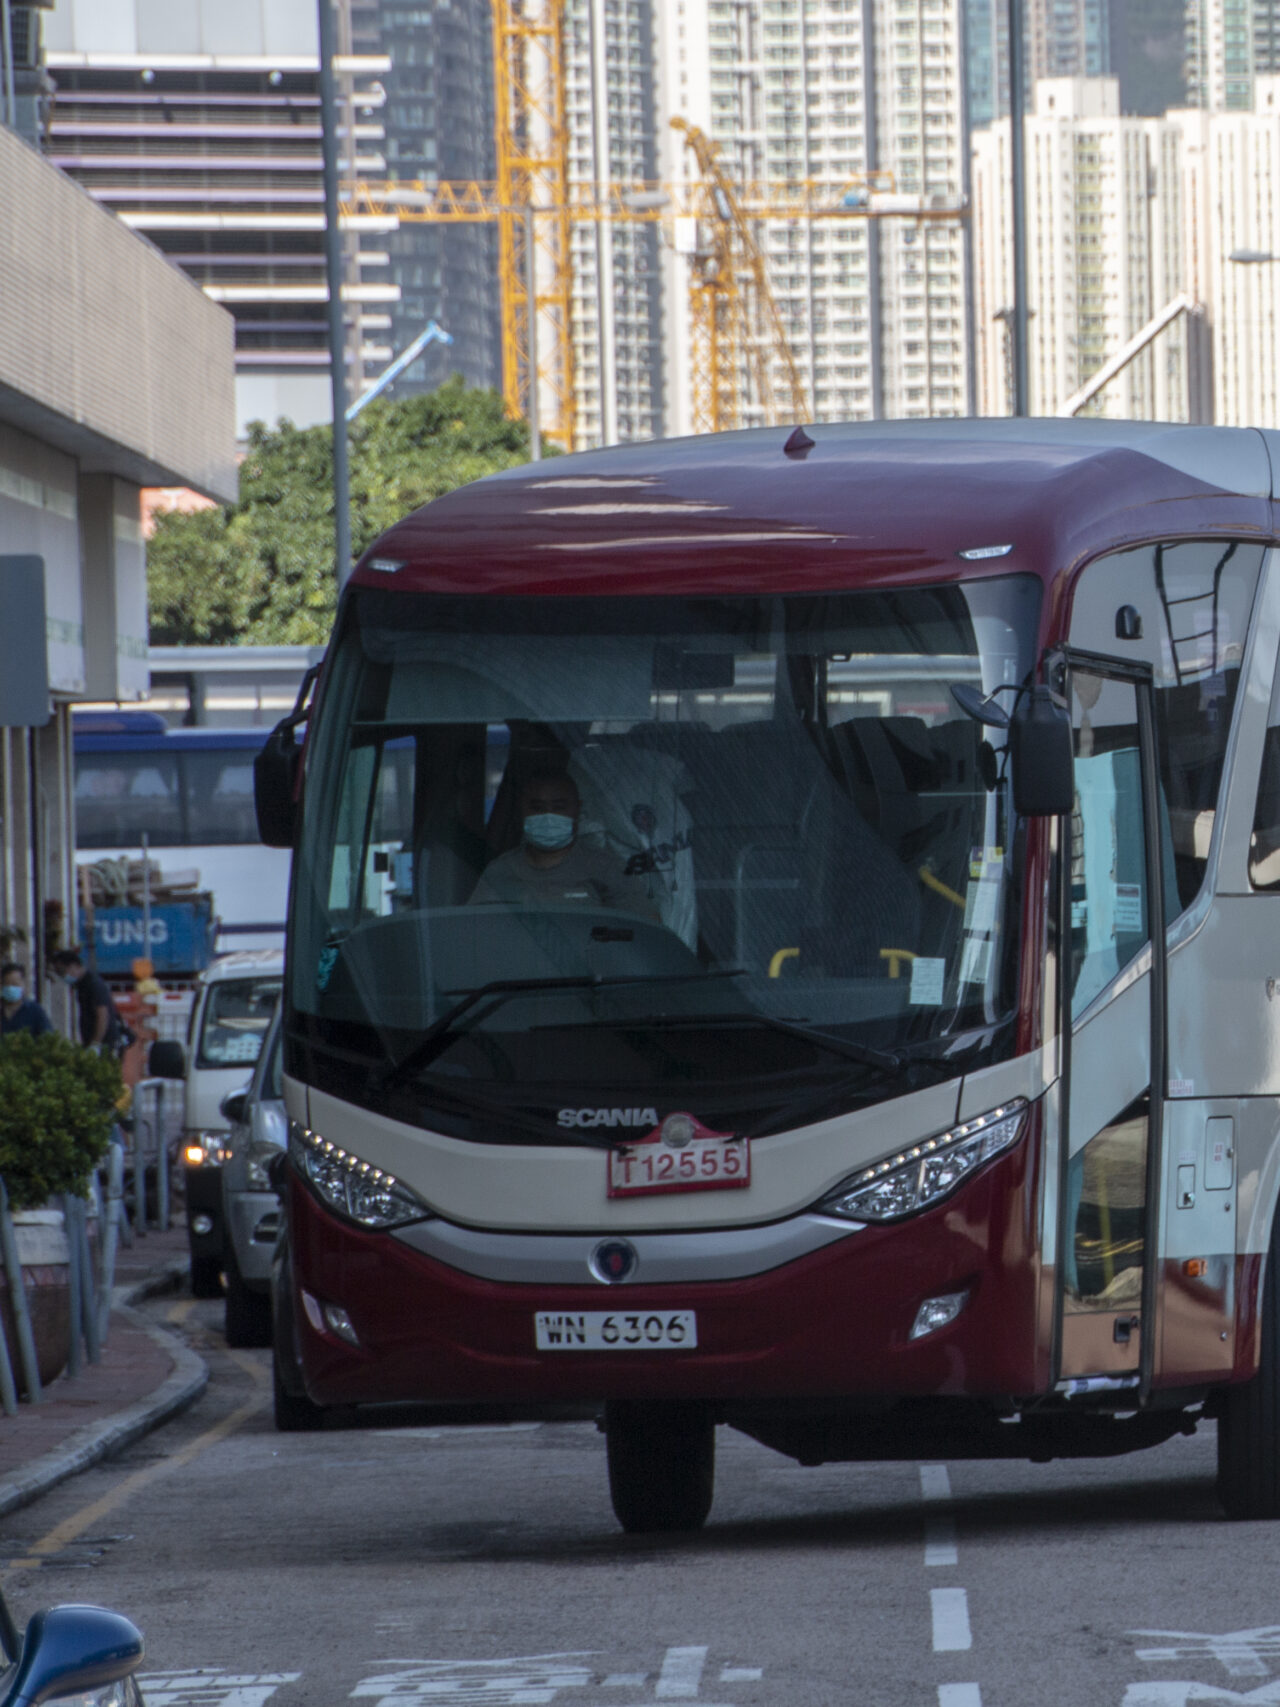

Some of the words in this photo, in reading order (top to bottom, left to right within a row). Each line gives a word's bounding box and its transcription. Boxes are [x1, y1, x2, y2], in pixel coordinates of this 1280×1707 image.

[556, 1107, 660, 1128] SCANIA
[617, 1147, 741, 1184] T12555
[545, 1316, 586, 1344] WN
[601, 1315, 687, 1344] 6306
